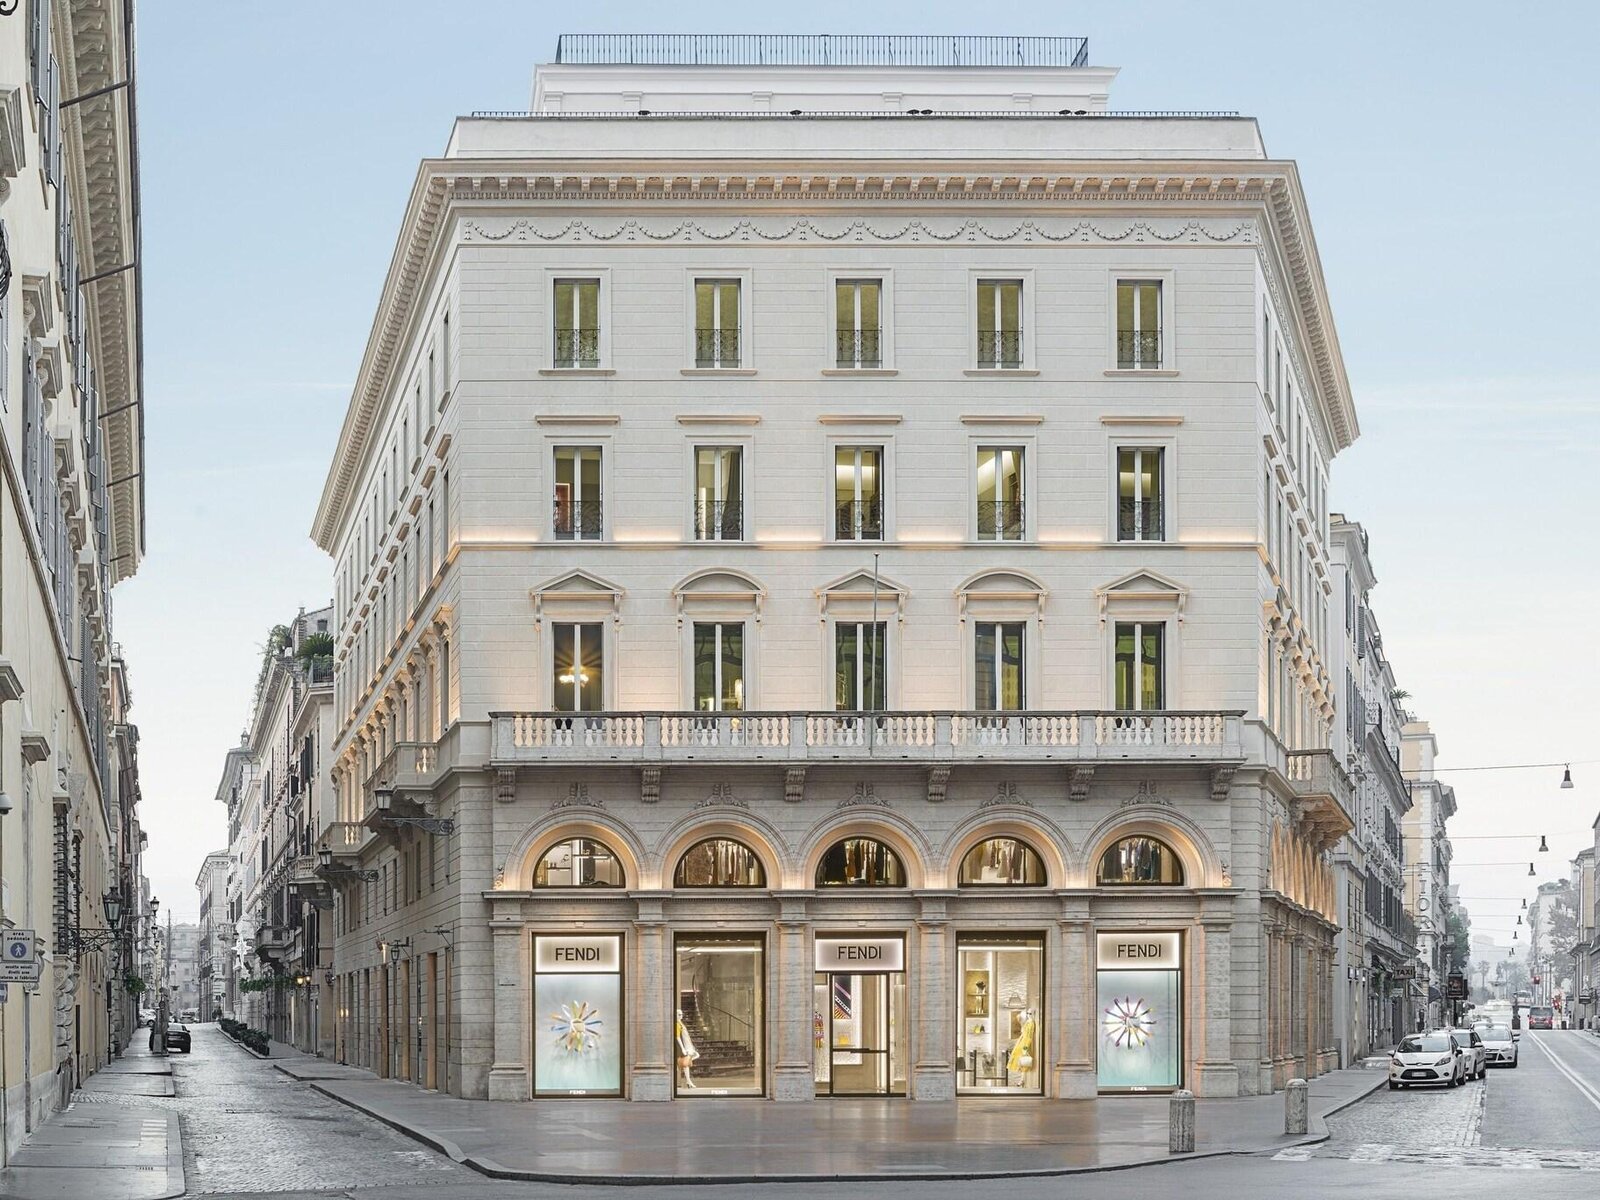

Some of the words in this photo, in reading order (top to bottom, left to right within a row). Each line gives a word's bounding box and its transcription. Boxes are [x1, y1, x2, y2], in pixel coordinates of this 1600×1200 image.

[555, 947, 600, 961] FENDI
[838, 945, 882, 960] FENDI
[1117, 944, 1161, 958] FENDI
